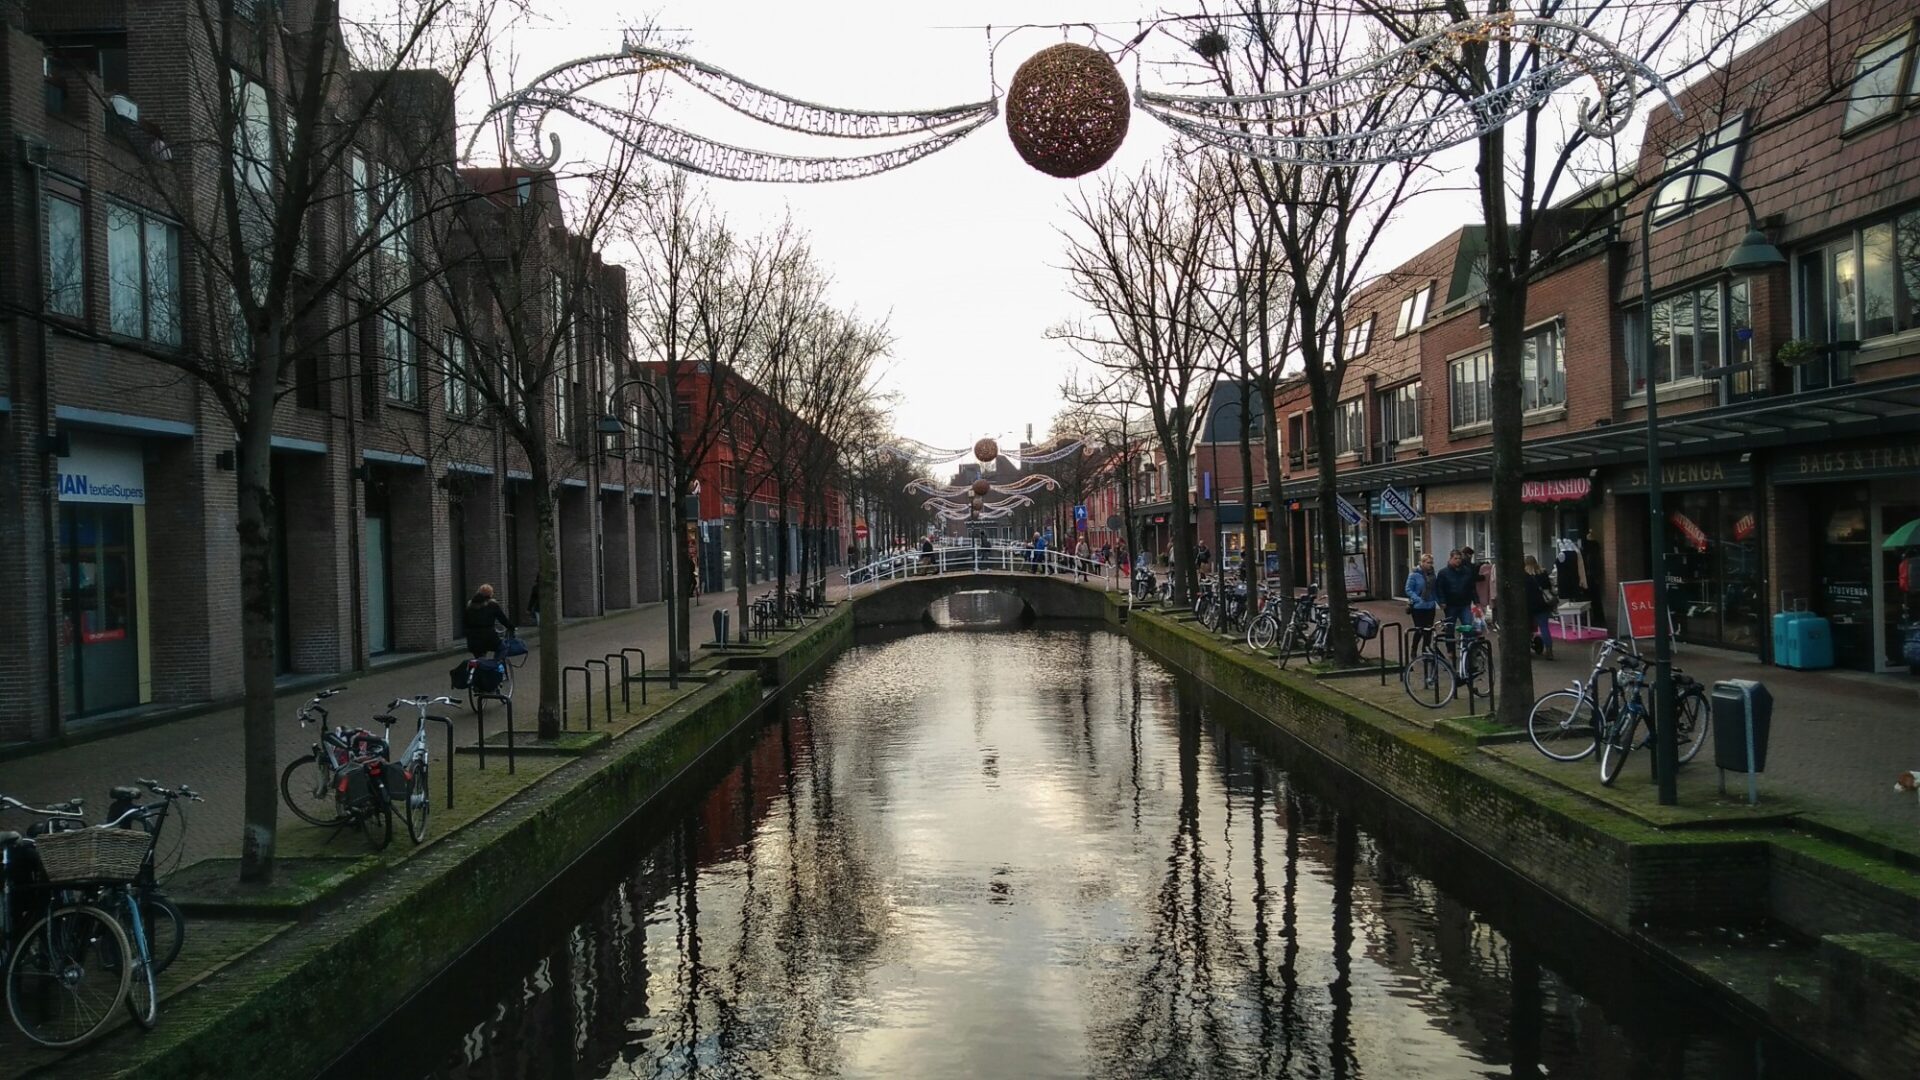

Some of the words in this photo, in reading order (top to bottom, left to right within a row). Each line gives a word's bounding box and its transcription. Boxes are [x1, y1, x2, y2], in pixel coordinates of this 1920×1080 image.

[1800, 452, 1846, 473] BAGS
[1853, 450, 1864, 470] &
[1631, 462, 1724, 486] STIVENGA
[89, 483, 143, 499] textielSupers
